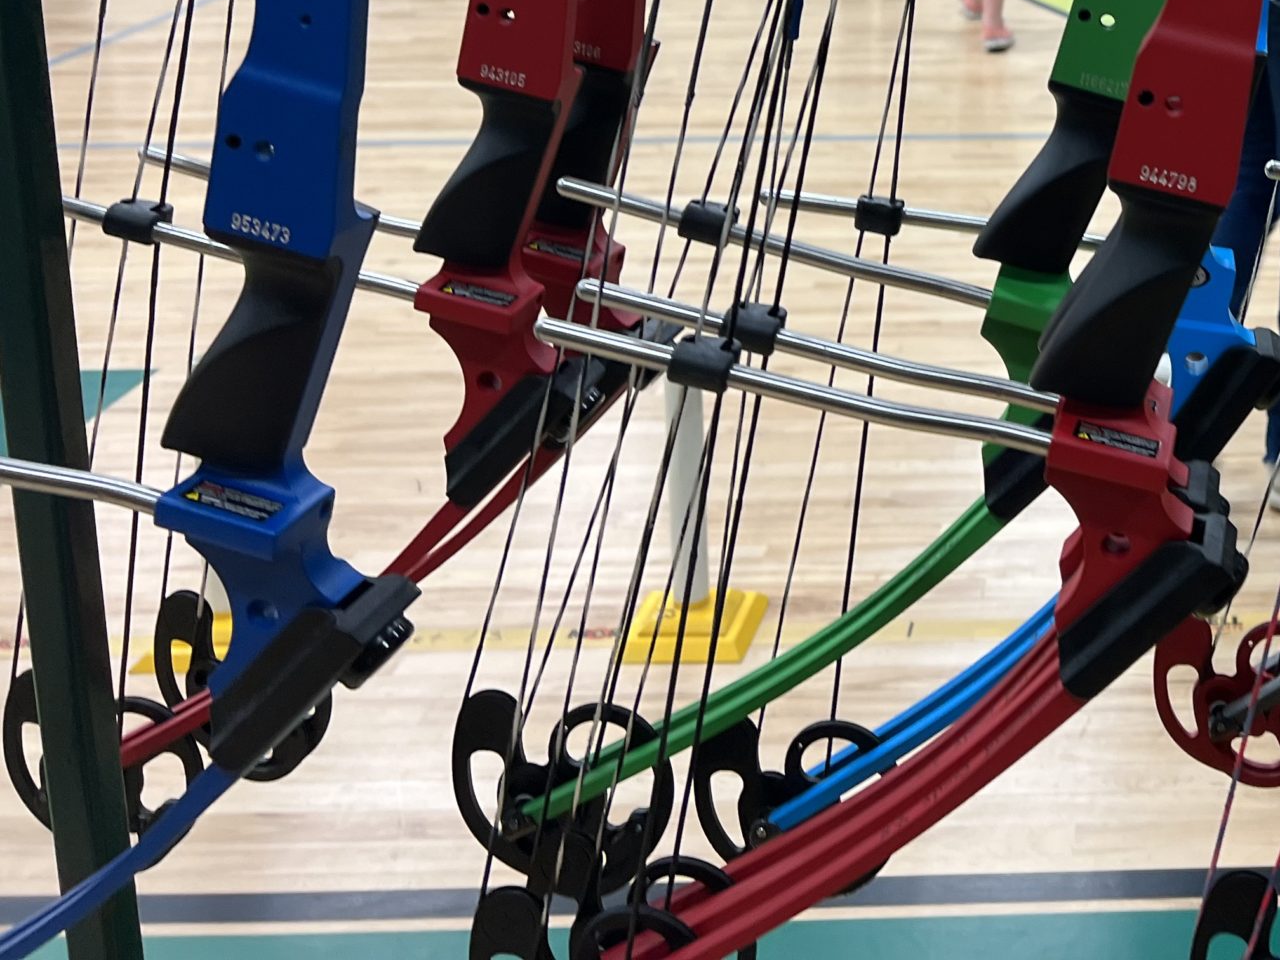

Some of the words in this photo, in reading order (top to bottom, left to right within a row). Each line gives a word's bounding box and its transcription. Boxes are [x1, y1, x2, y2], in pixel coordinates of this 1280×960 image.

[479, 62, 527, 89] 943105
[1139, 164, 1198, 194] 944798
[230, 211, 291, 245] 953473
